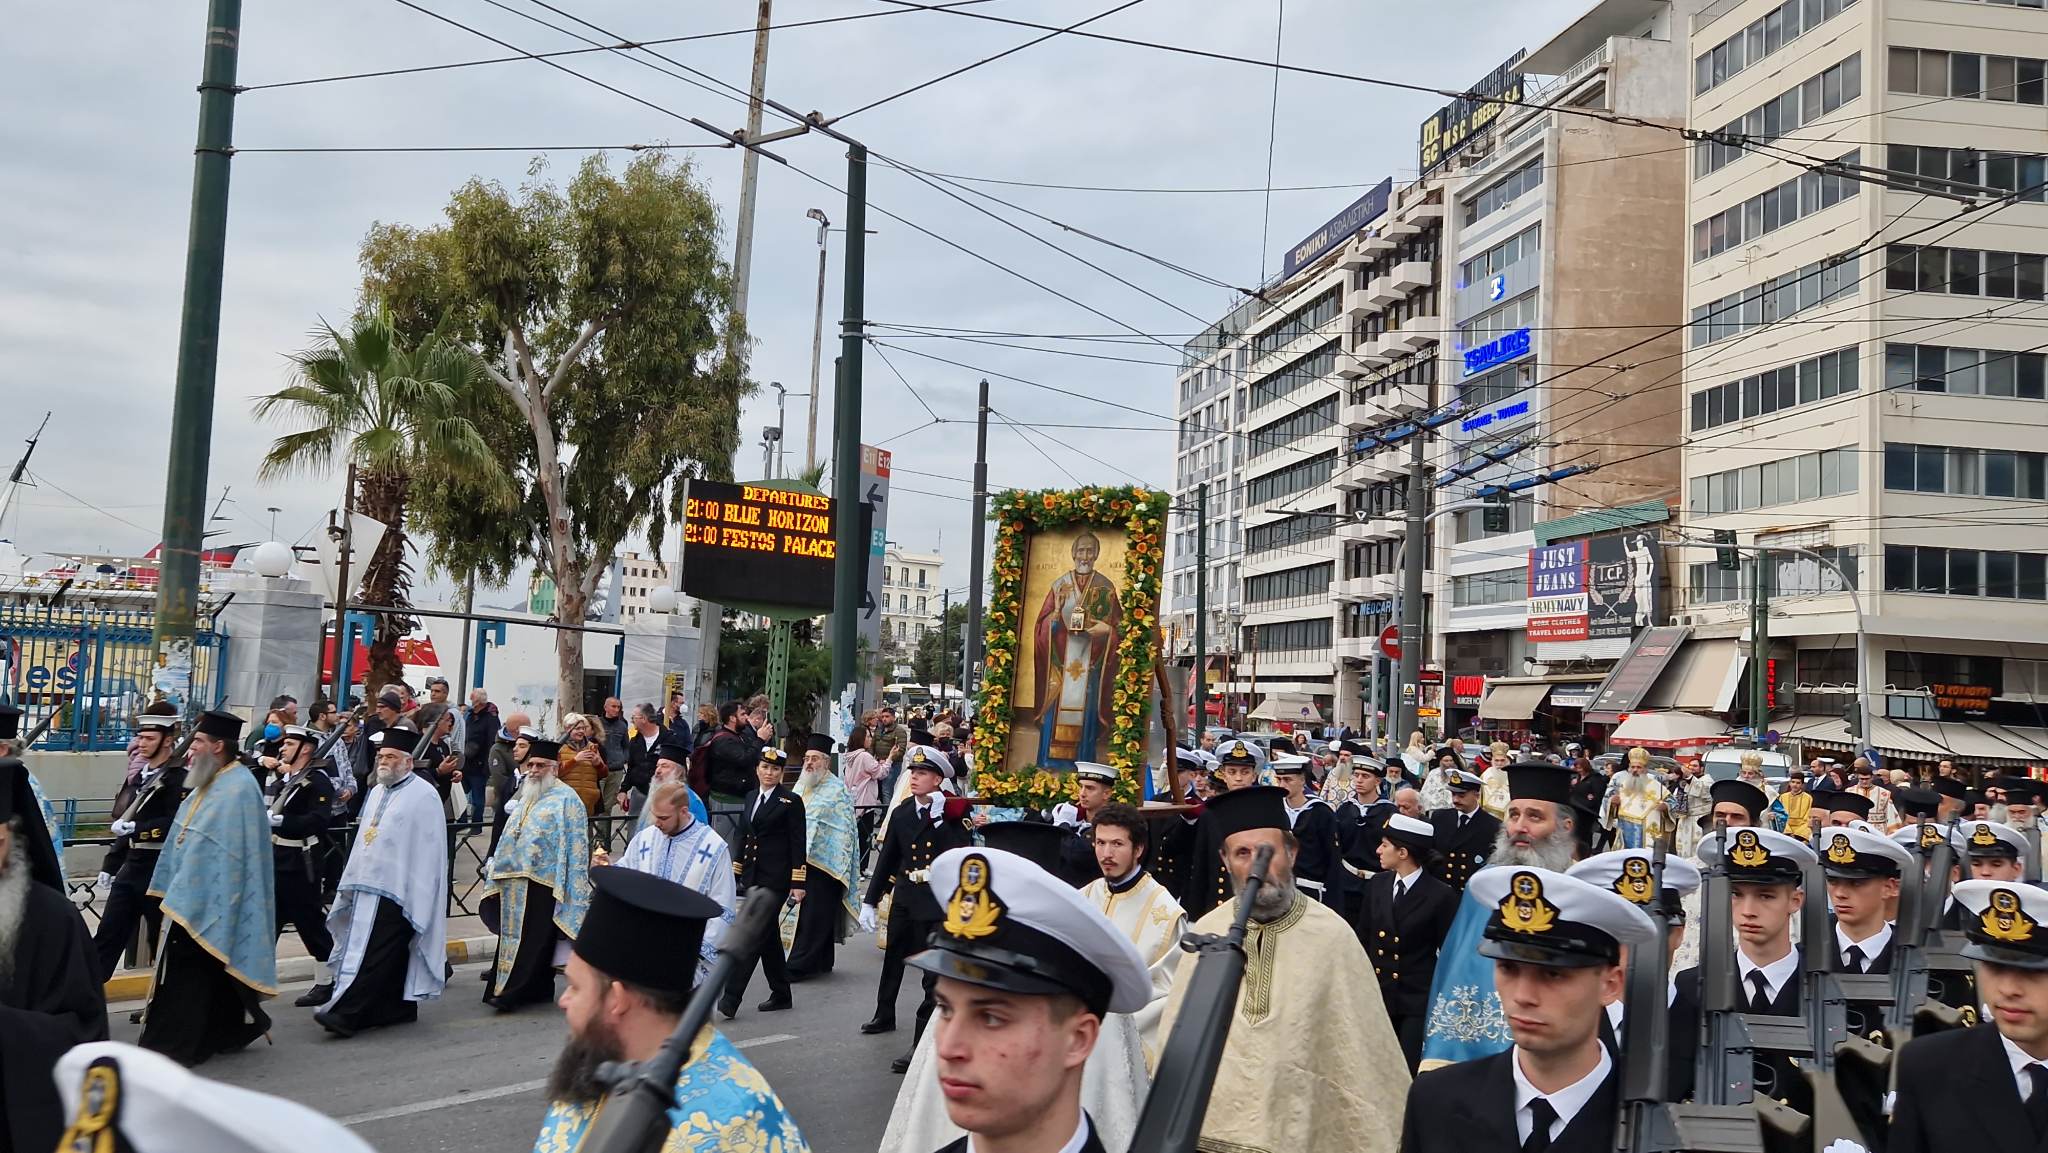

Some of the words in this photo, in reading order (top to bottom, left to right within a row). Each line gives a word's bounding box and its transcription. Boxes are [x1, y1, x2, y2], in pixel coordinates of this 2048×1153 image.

[878, 450, 891, 470] E12
[743, 486, 830, 511] DEPARTURES
[686, 498, 719, 520] 21:00
[723, 503, 761, 526] BLUE
[767, 508, 829, 534] HORIZON
[685, 523, 718, 545] 21:00
[721, 527, 776, 552] FESTOS
[783, 535, 836, 559] PALACE
[873, 530, 884, 547] E3
[1540, 547, 1576, 570] JUST
[1536, 571, 1576, 592] JEANS
[1528, 629, 1552, 637] TRAVEL
[1553, 627, 1585, 636] LUGGAGE
[1531, 619, 1550, 627] WORK
[1551, 617, 1581, 626] CLOTHES
